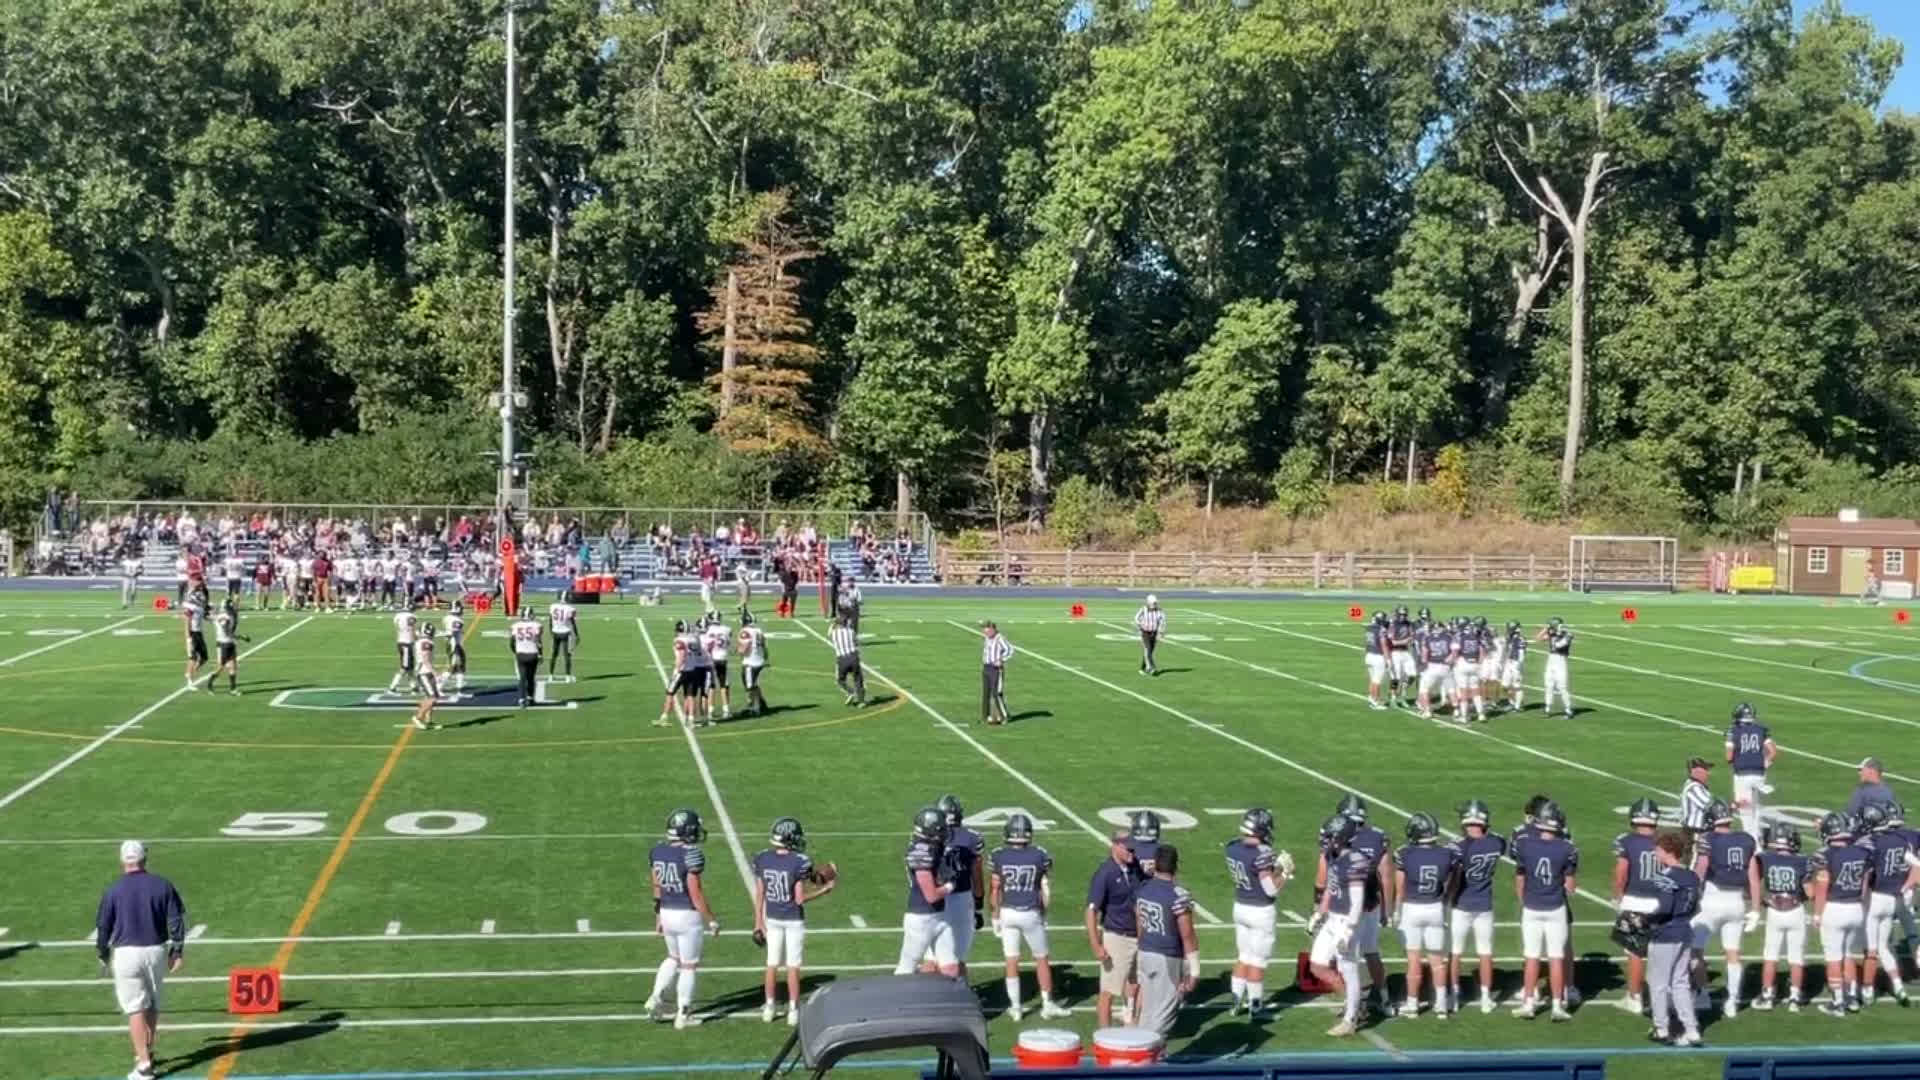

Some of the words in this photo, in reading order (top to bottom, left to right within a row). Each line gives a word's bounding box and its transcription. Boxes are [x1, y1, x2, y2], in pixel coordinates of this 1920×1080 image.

[516, 627, 534, 642] 55
[763, 869, 790, 903] 31
[1418, 865, 1438, 894] 5
[1535, 856, 1553, 886] 4
[234, 974, 274, 1008] 50
